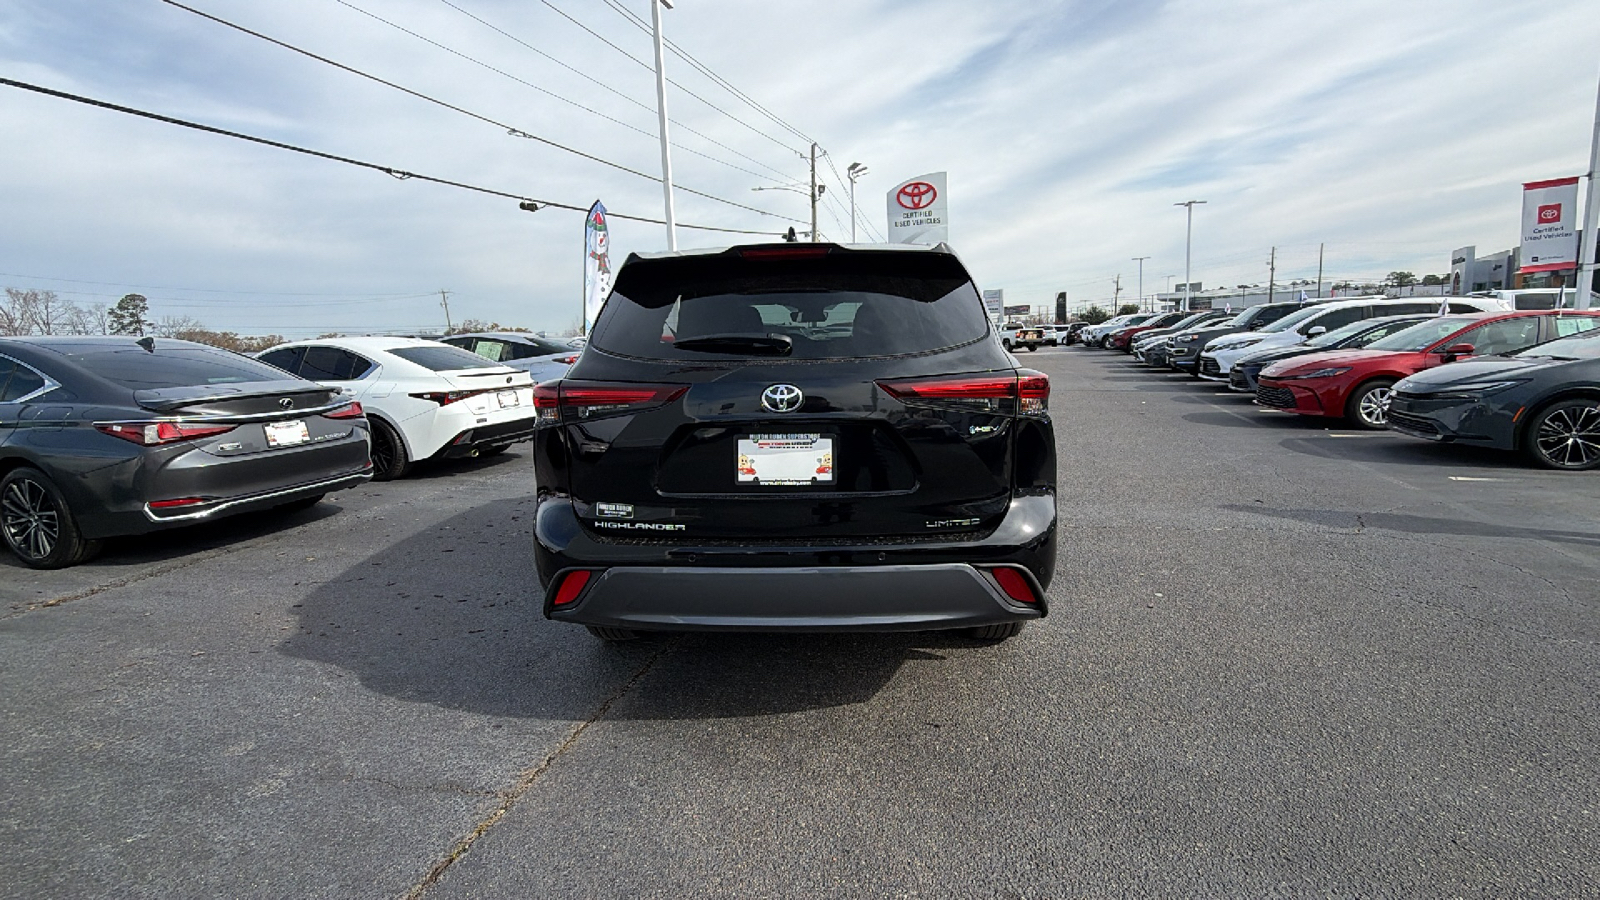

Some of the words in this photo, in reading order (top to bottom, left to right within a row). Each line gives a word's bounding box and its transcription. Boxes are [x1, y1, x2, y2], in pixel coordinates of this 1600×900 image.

[902, 210, 933, 219] CERTIFIED
[912, 217, 941, 226] VEHICLES
[1533, 226, 1564, 234] Certified
[594, 521, 686, 531] HIGHLANDER
